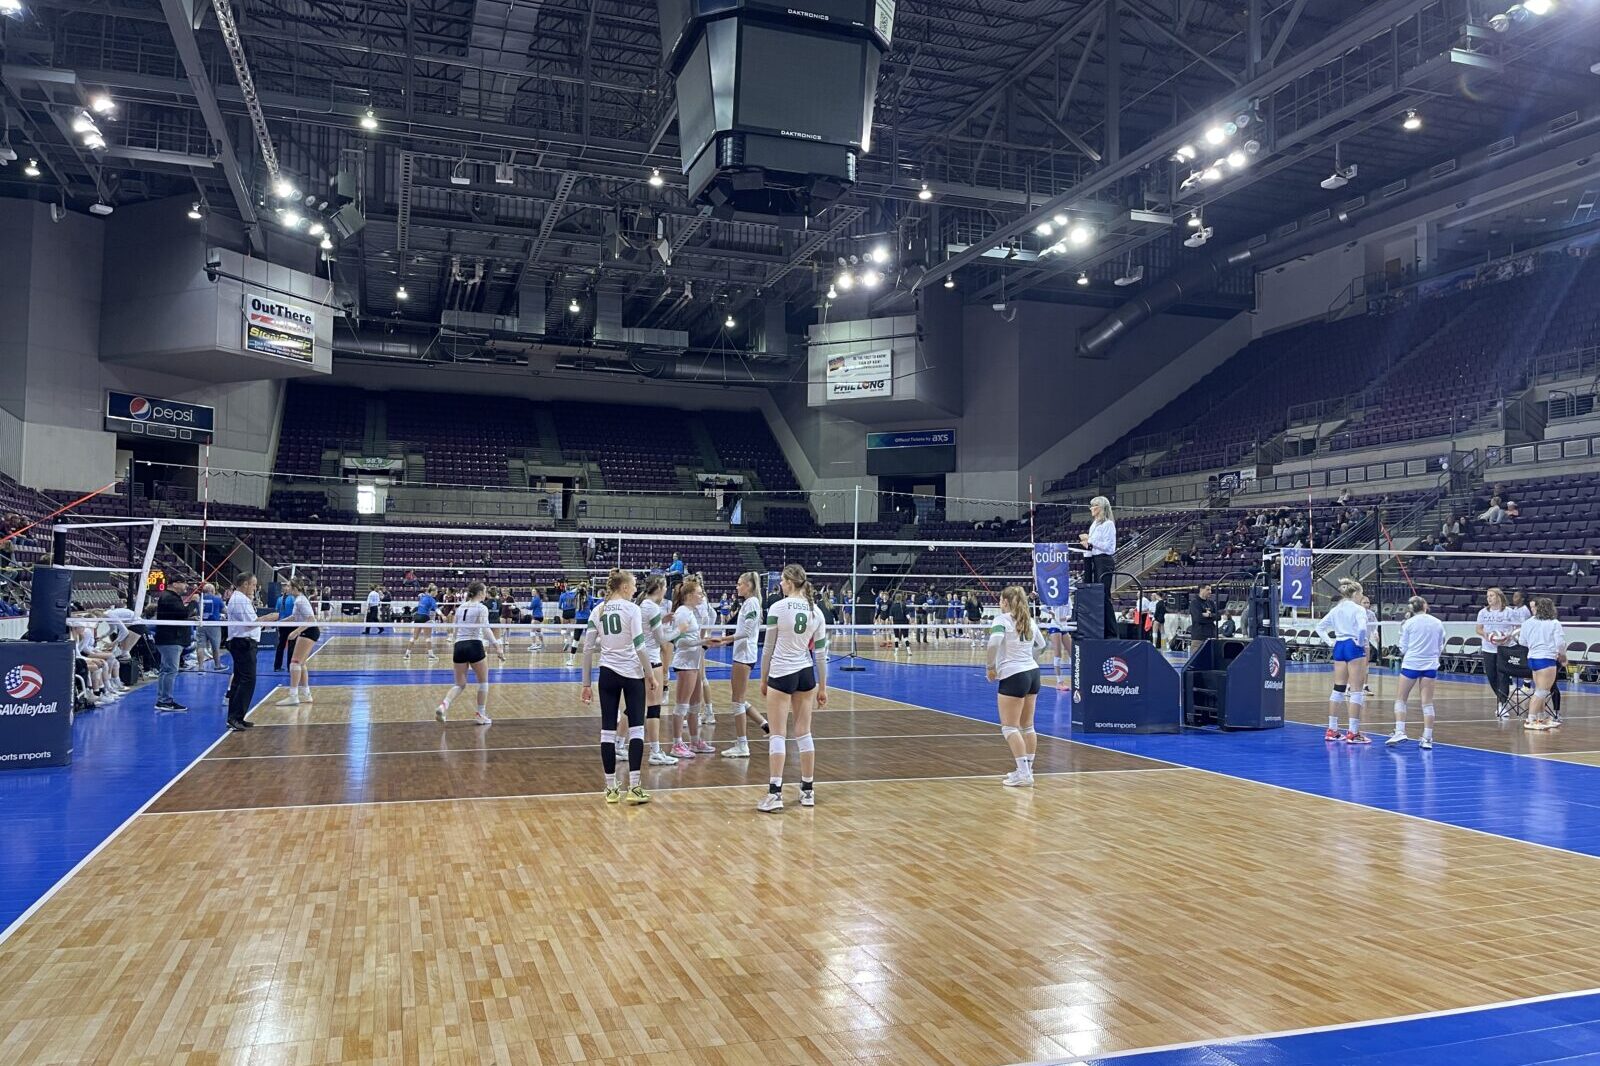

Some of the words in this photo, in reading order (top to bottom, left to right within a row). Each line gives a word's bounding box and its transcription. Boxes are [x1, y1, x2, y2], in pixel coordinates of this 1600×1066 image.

[787, 8, 829, 21] DAKTRONICS
[780, 130, 822, 140] DAKTRONICS
[251, 298, 312, 325] OutThere
[153, 406, 193, 421] pepsi
[1035, 552, 1069, 563] COURT
[1283, 555, 1311, 567] COURT
[1046, 577, 1059, 599] 3
[1291, 579, 1303, 600] 2
[604, 603, 622, 611] SSIL
[787, 602, 809, 611] FOSSI
[462, 609, 469, 622] 1
[600, 613, 622, 636] 10
[794, 612, 808, 635] 8
[1091, 685, 1140, 697] USAVolleyball
[0, 753, 18, 761] orts
[18, 751, 52, 761] imports
